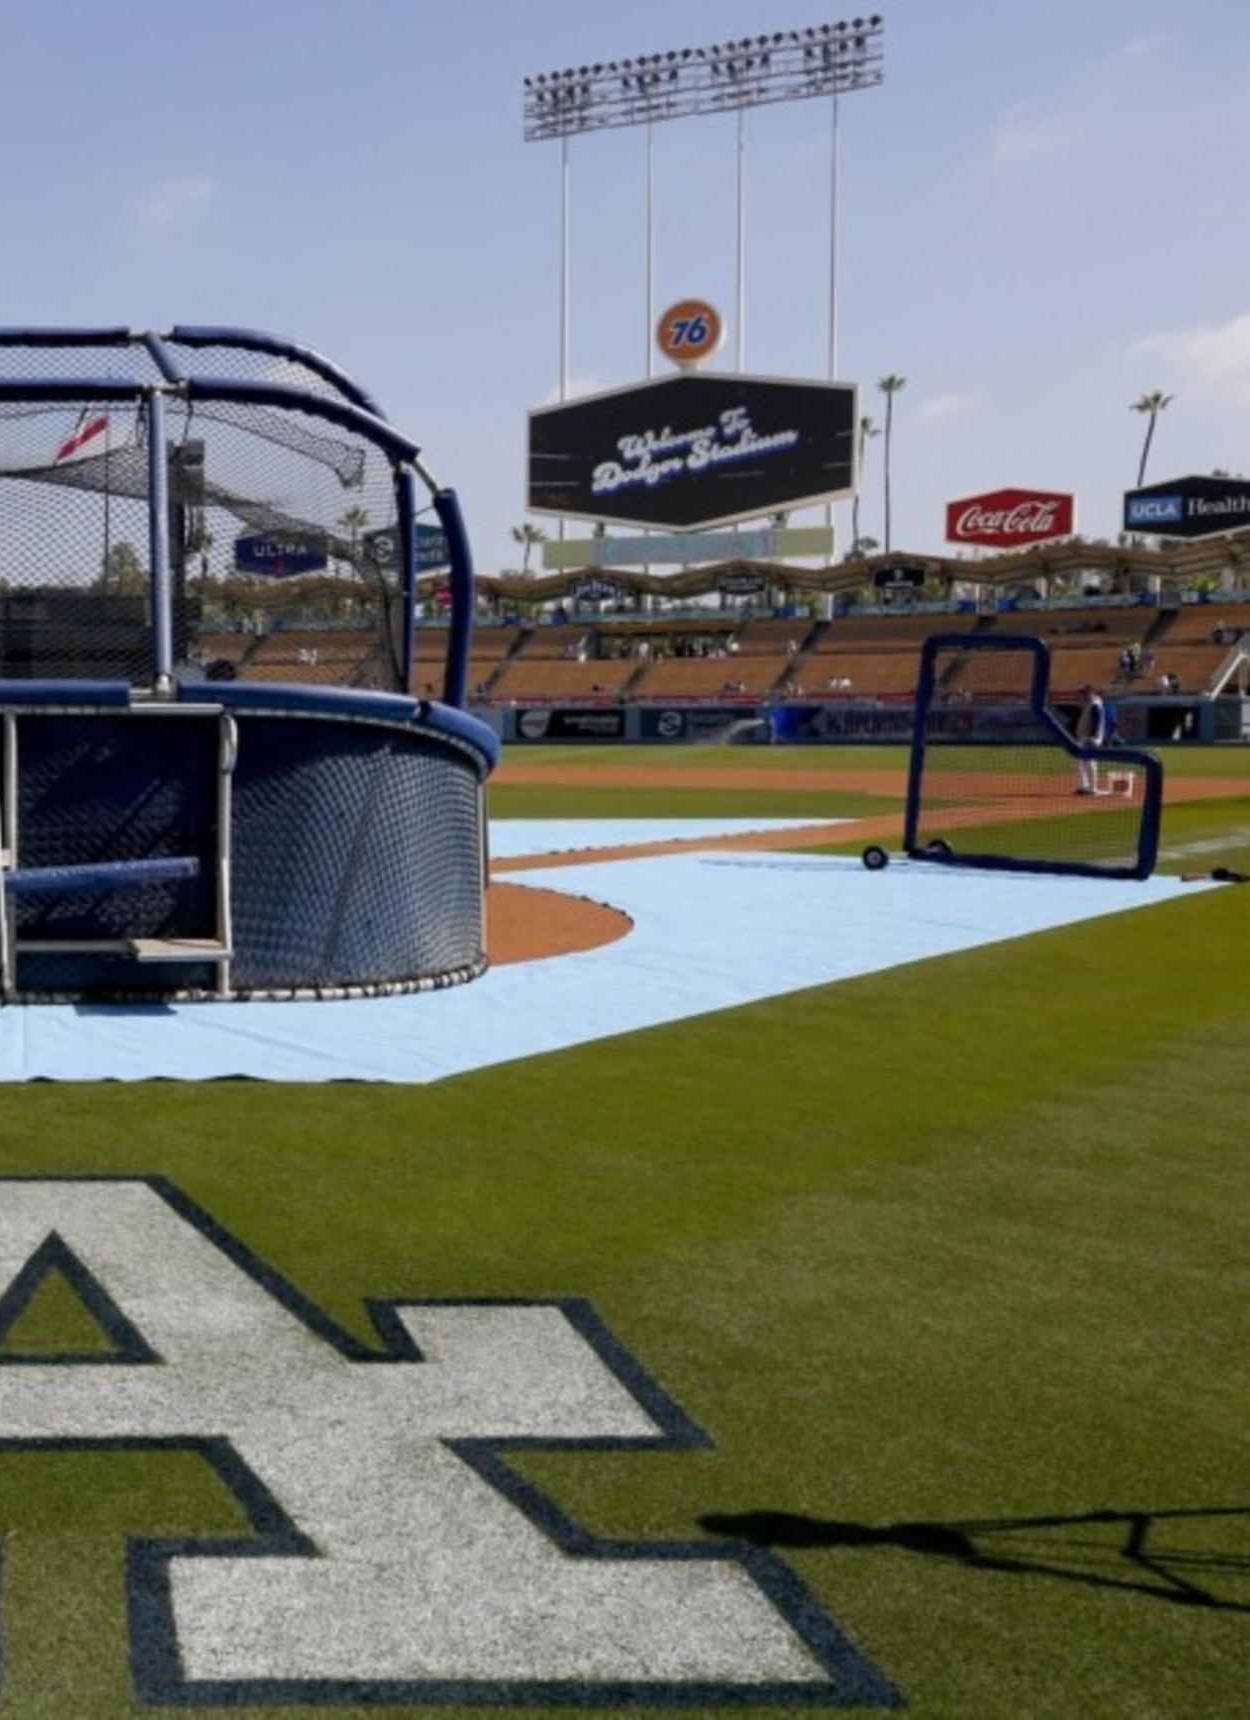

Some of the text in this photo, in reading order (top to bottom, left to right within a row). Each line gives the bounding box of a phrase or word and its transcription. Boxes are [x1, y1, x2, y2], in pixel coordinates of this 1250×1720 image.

[669, 316, 707, 346] 76
[617, 407, 750, 459] Welcome To
[592, 427, 798, 492] Dodger Stadium
[1131, 503, 1177, 518] UCLA
[253, 543, 307, 558] ULTRA
